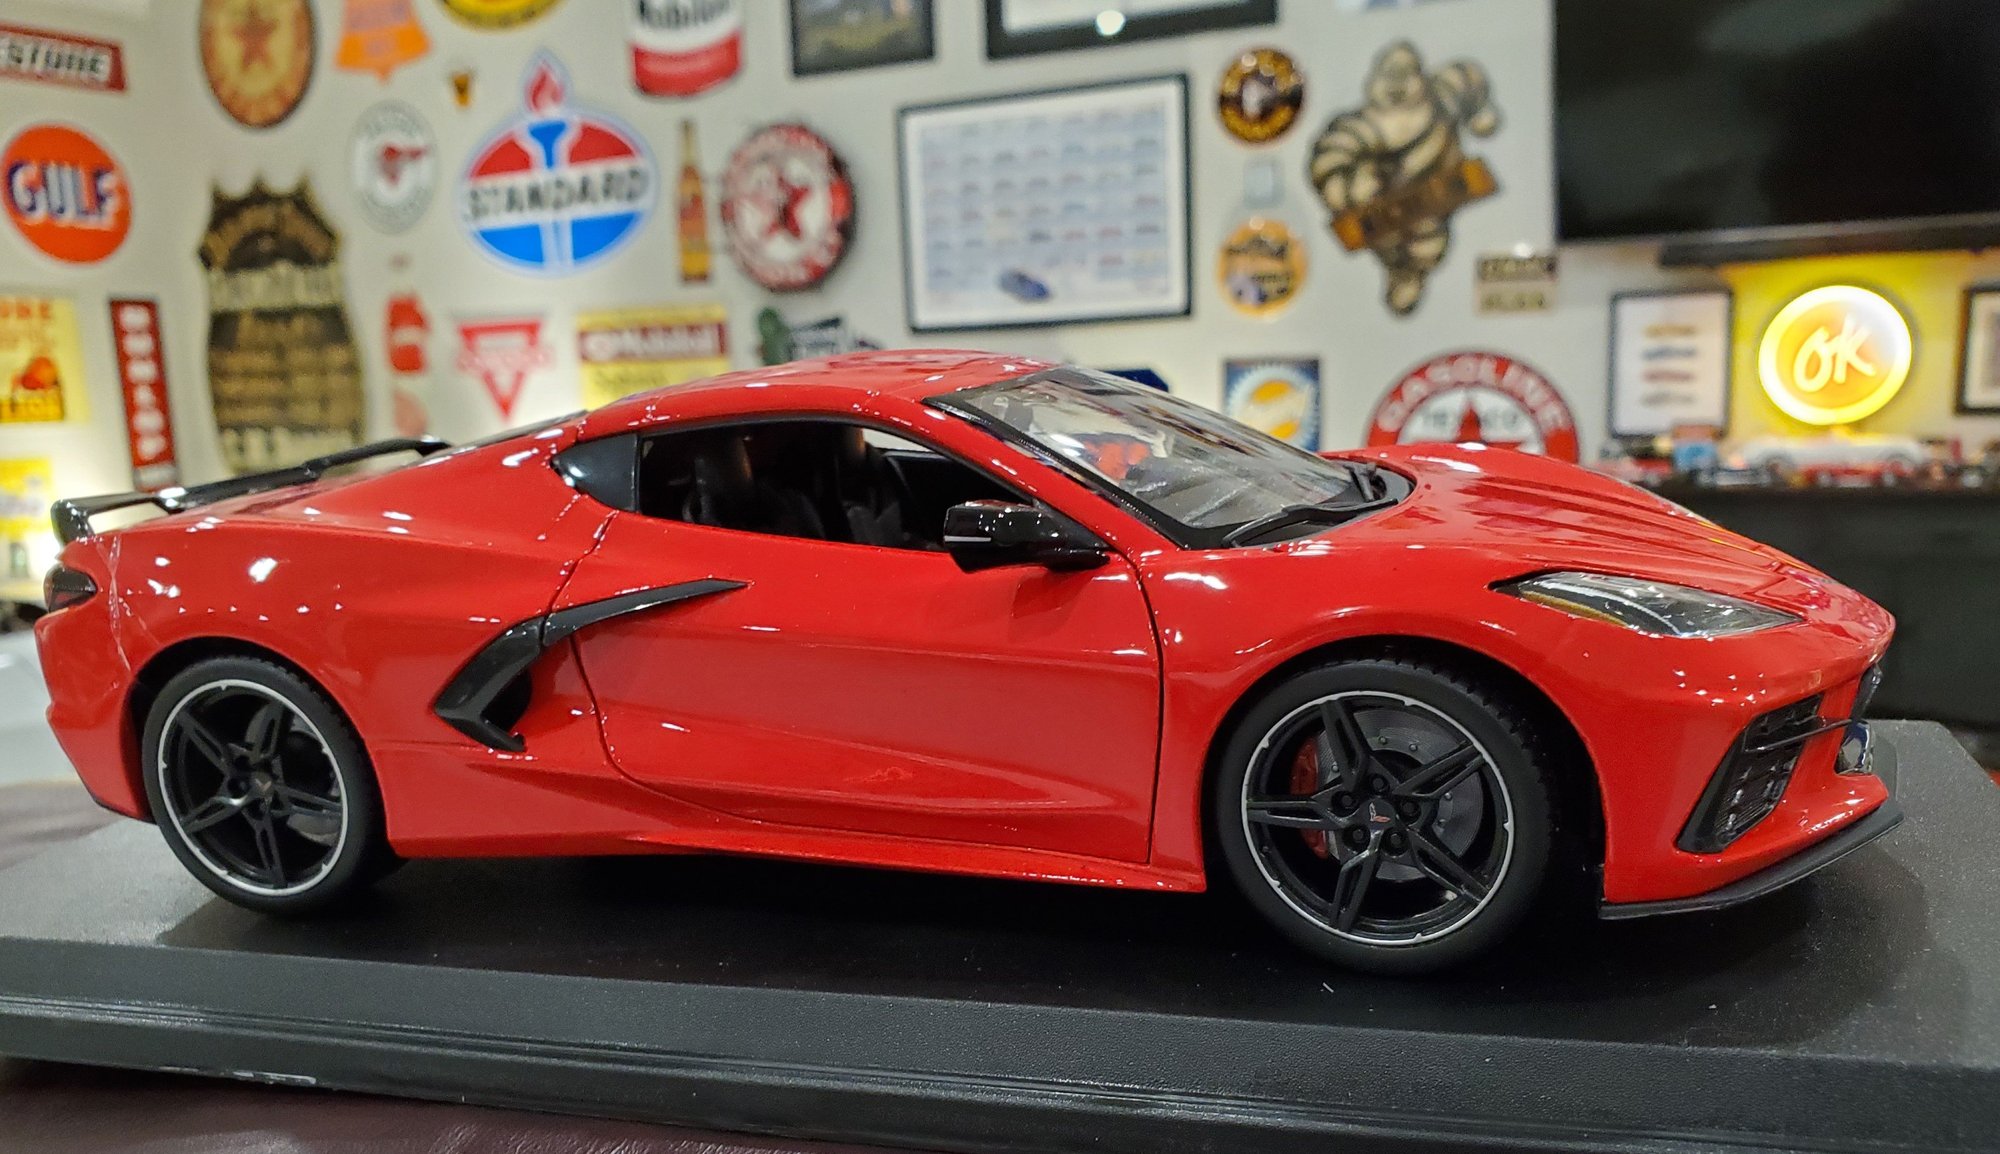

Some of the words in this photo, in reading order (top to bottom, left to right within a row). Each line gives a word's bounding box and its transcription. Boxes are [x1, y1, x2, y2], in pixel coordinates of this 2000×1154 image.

[8, 160, 118, 231] GULF
[464, 167, 650, 221] STANDARD
[1793, 312, 1876, 392] OK
[1377, 354, 1572, 433] GASOLINE
